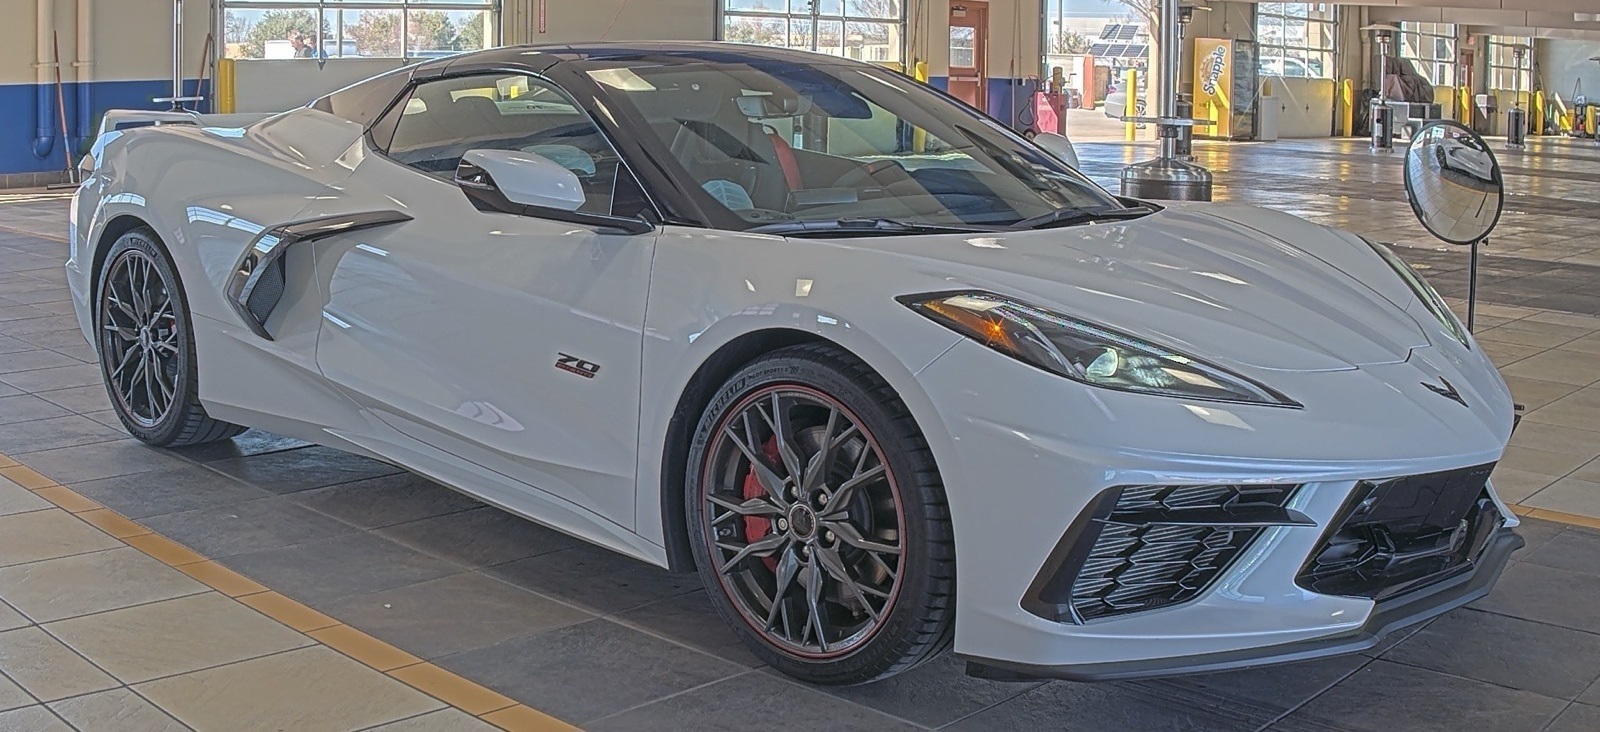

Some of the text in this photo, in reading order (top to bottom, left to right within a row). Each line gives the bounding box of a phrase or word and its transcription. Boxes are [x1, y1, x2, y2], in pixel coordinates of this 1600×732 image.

[1203, 46, 1226, 95] Snapple
[558, 352, 600, 373] 70
[704, 376, 745, 431] MICHELIN
